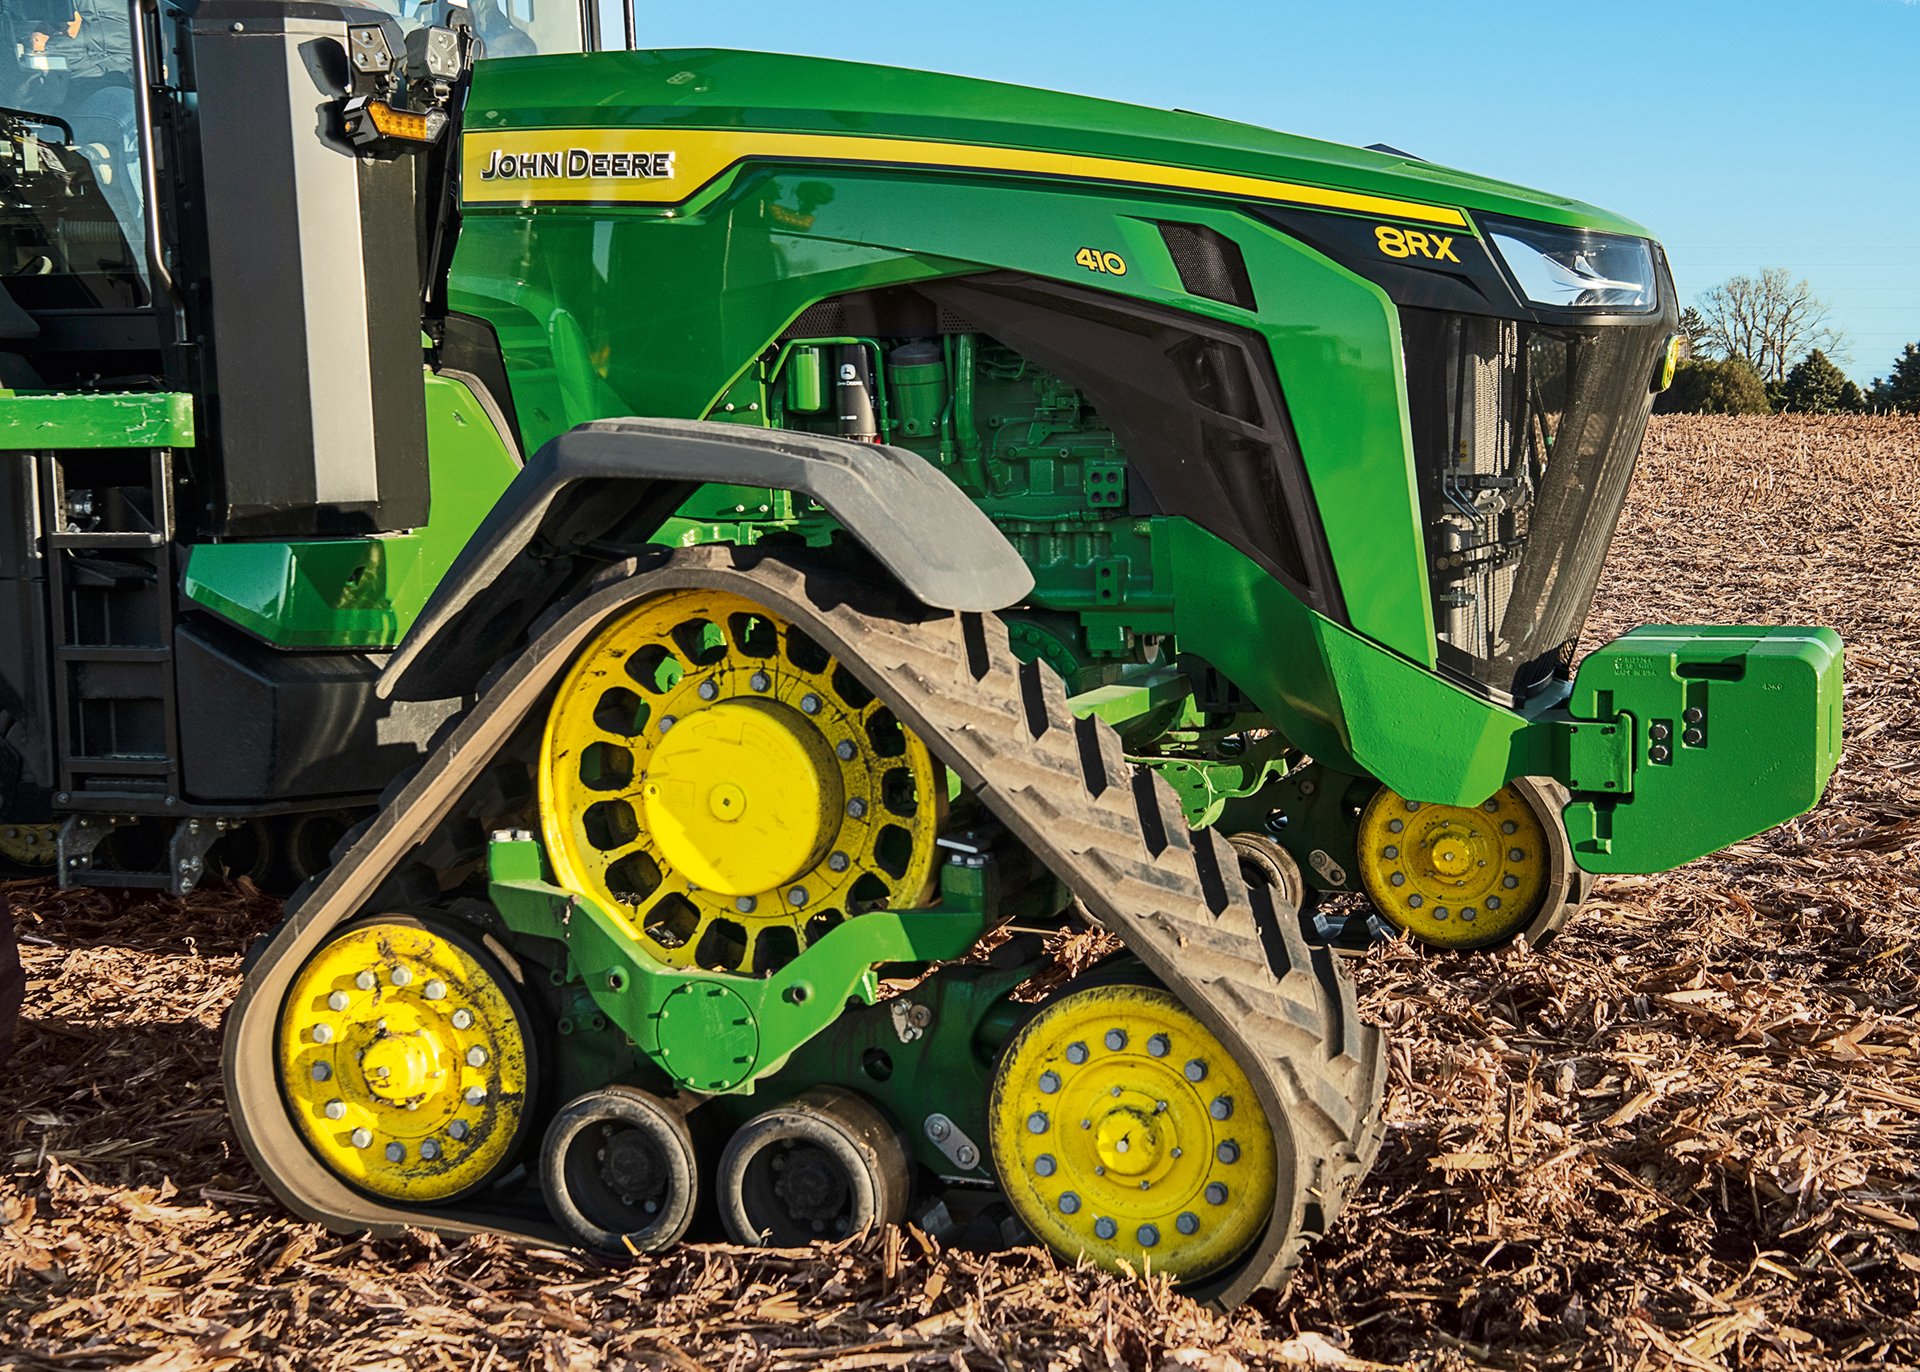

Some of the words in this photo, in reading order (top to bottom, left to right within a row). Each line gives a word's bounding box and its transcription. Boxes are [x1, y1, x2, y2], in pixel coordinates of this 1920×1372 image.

[480, 149, 564, 181] JOHN
[566, 148, 676, 180] DEERE
[1074, 246, 1127, 277] 410
[1374, 226, 1461, 264] 8RX
